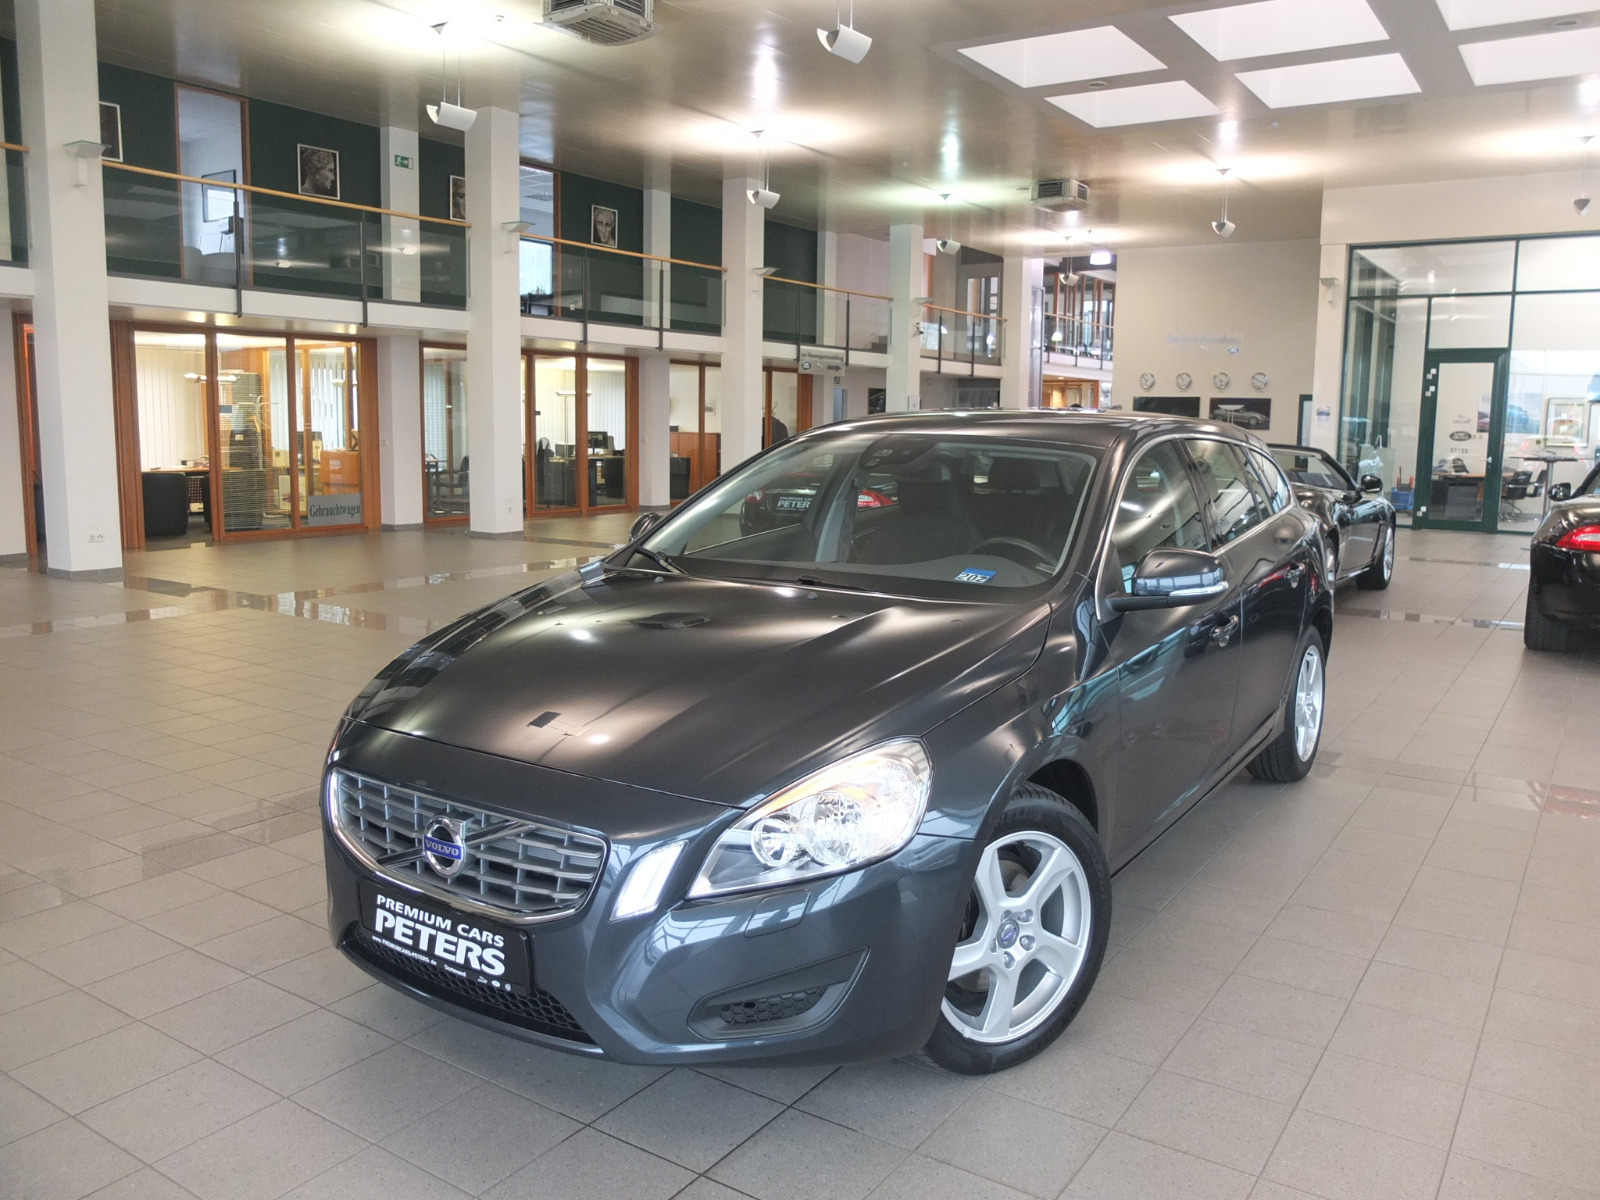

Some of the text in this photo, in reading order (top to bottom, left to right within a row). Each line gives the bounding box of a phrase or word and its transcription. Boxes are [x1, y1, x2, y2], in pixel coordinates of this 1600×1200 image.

[310, 503, 361, 518] Gebrauchtwagen
[777, 500, 811, 509] PETER
[425, 839, 460, 856] VOLVO
[376, 894, 505, 947] PREMIUM CARS
[375, 907, 505, 976] PETERS
